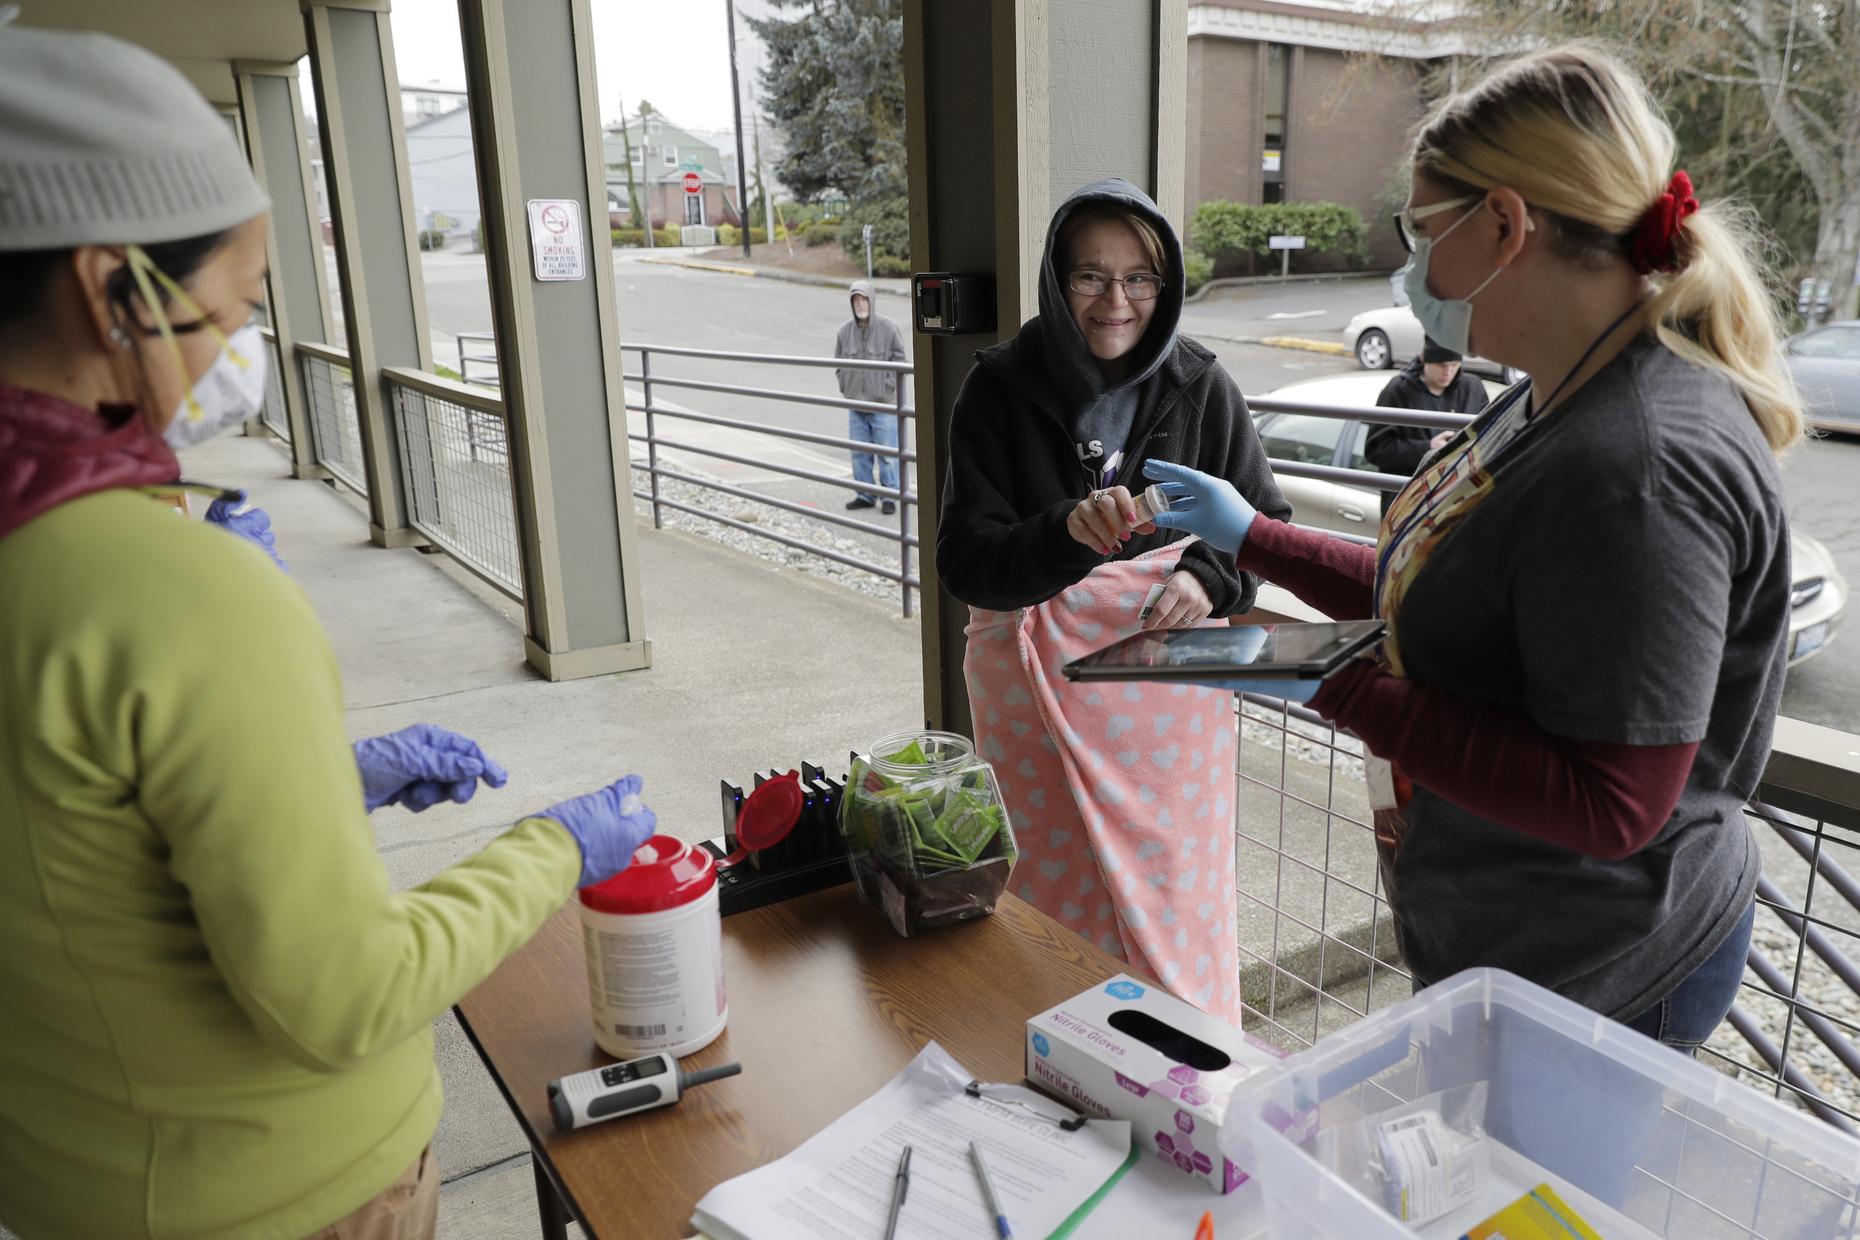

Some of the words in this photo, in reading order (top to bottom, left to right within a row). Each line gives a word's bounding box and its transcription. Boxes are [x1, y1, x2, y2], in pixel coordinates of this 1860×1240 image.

[543, 246, 575, 255] SMOKING
[553, 235, 563, 245] NO
[1050, 1013, 1087, 1035] Nitrile
[1087, 1031, 1127, 1056] Gloves
[1034, 1061, 1069, 1092] Nitrile
[1071, 1085, 1111, 1118] Gloves
